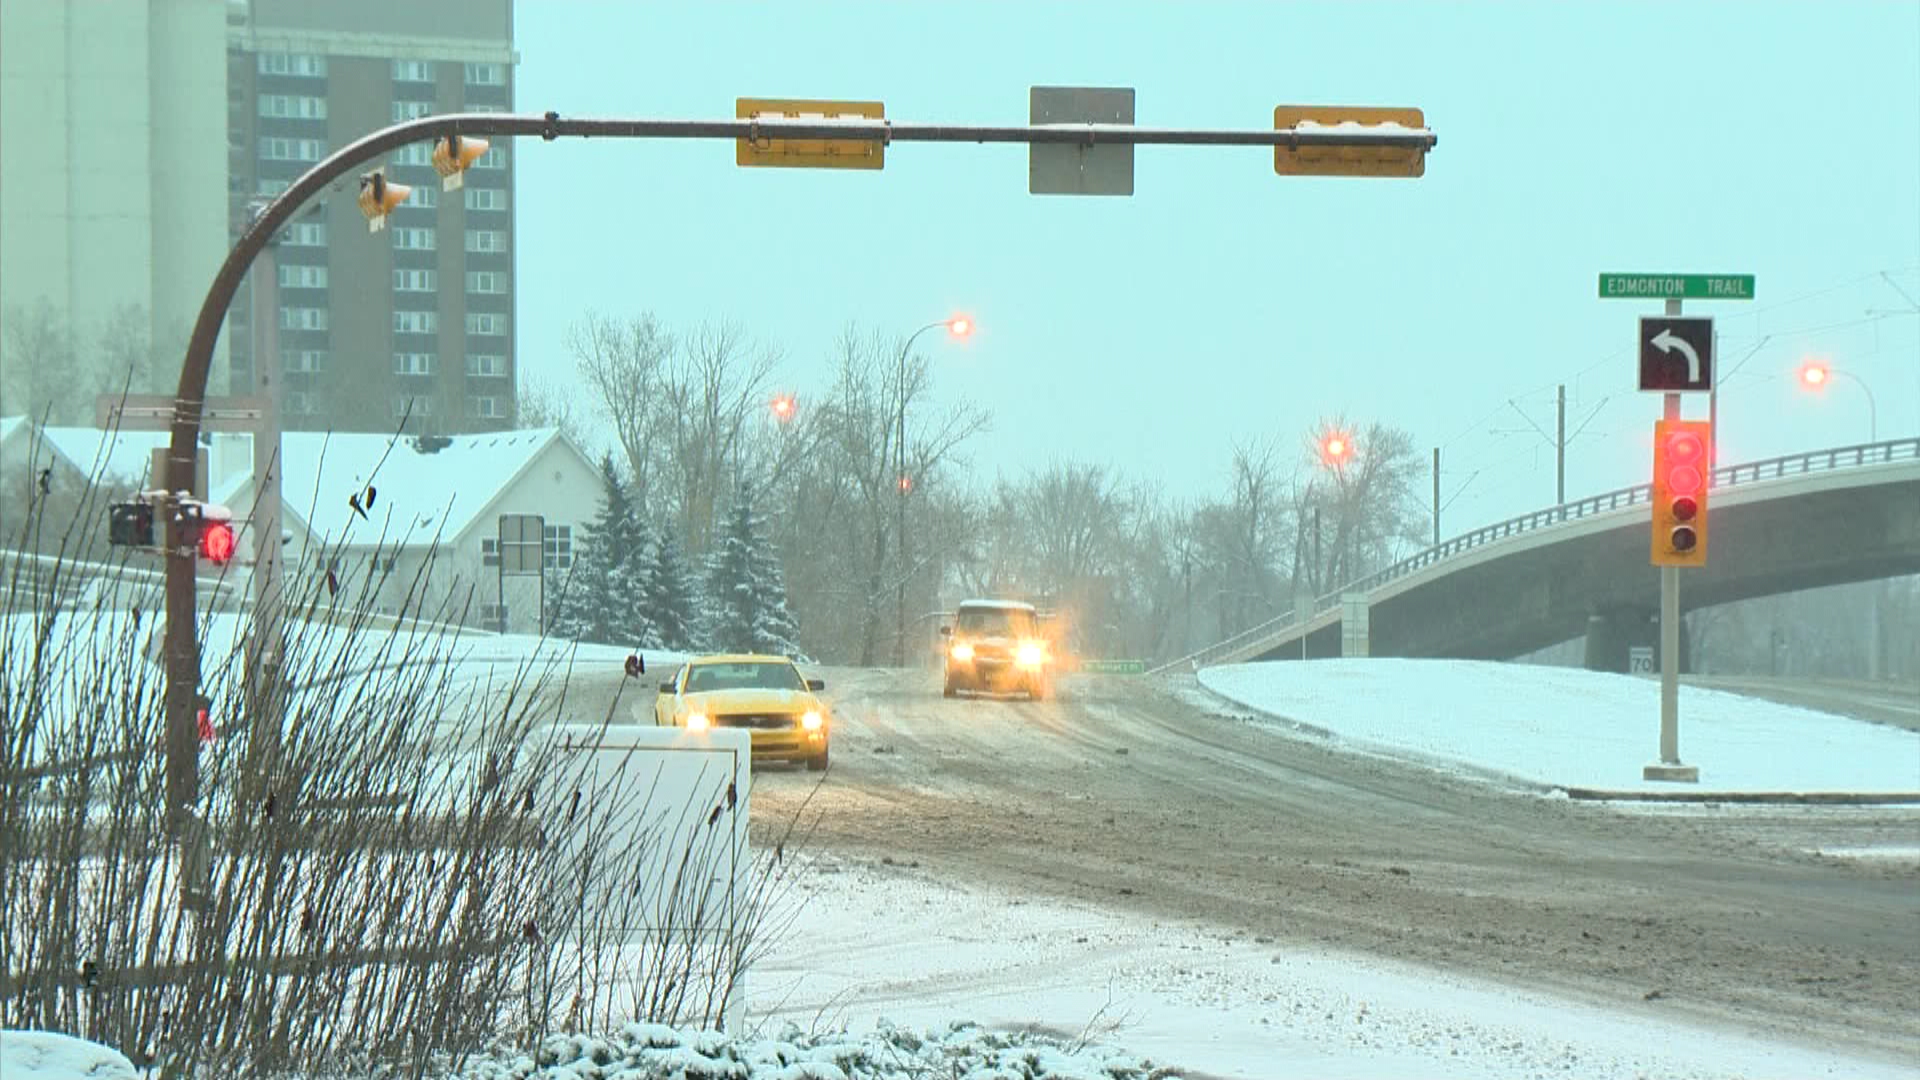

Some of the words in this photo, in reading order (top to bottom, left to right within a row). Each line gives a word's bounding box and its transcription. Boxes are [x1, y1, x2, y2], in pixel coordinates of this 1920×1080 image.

[1607, 278, 1684, 294] EDMONTON
[1707, 279, 1746, 295] TRAIL
[1632, 657, 1652, 672] 70
